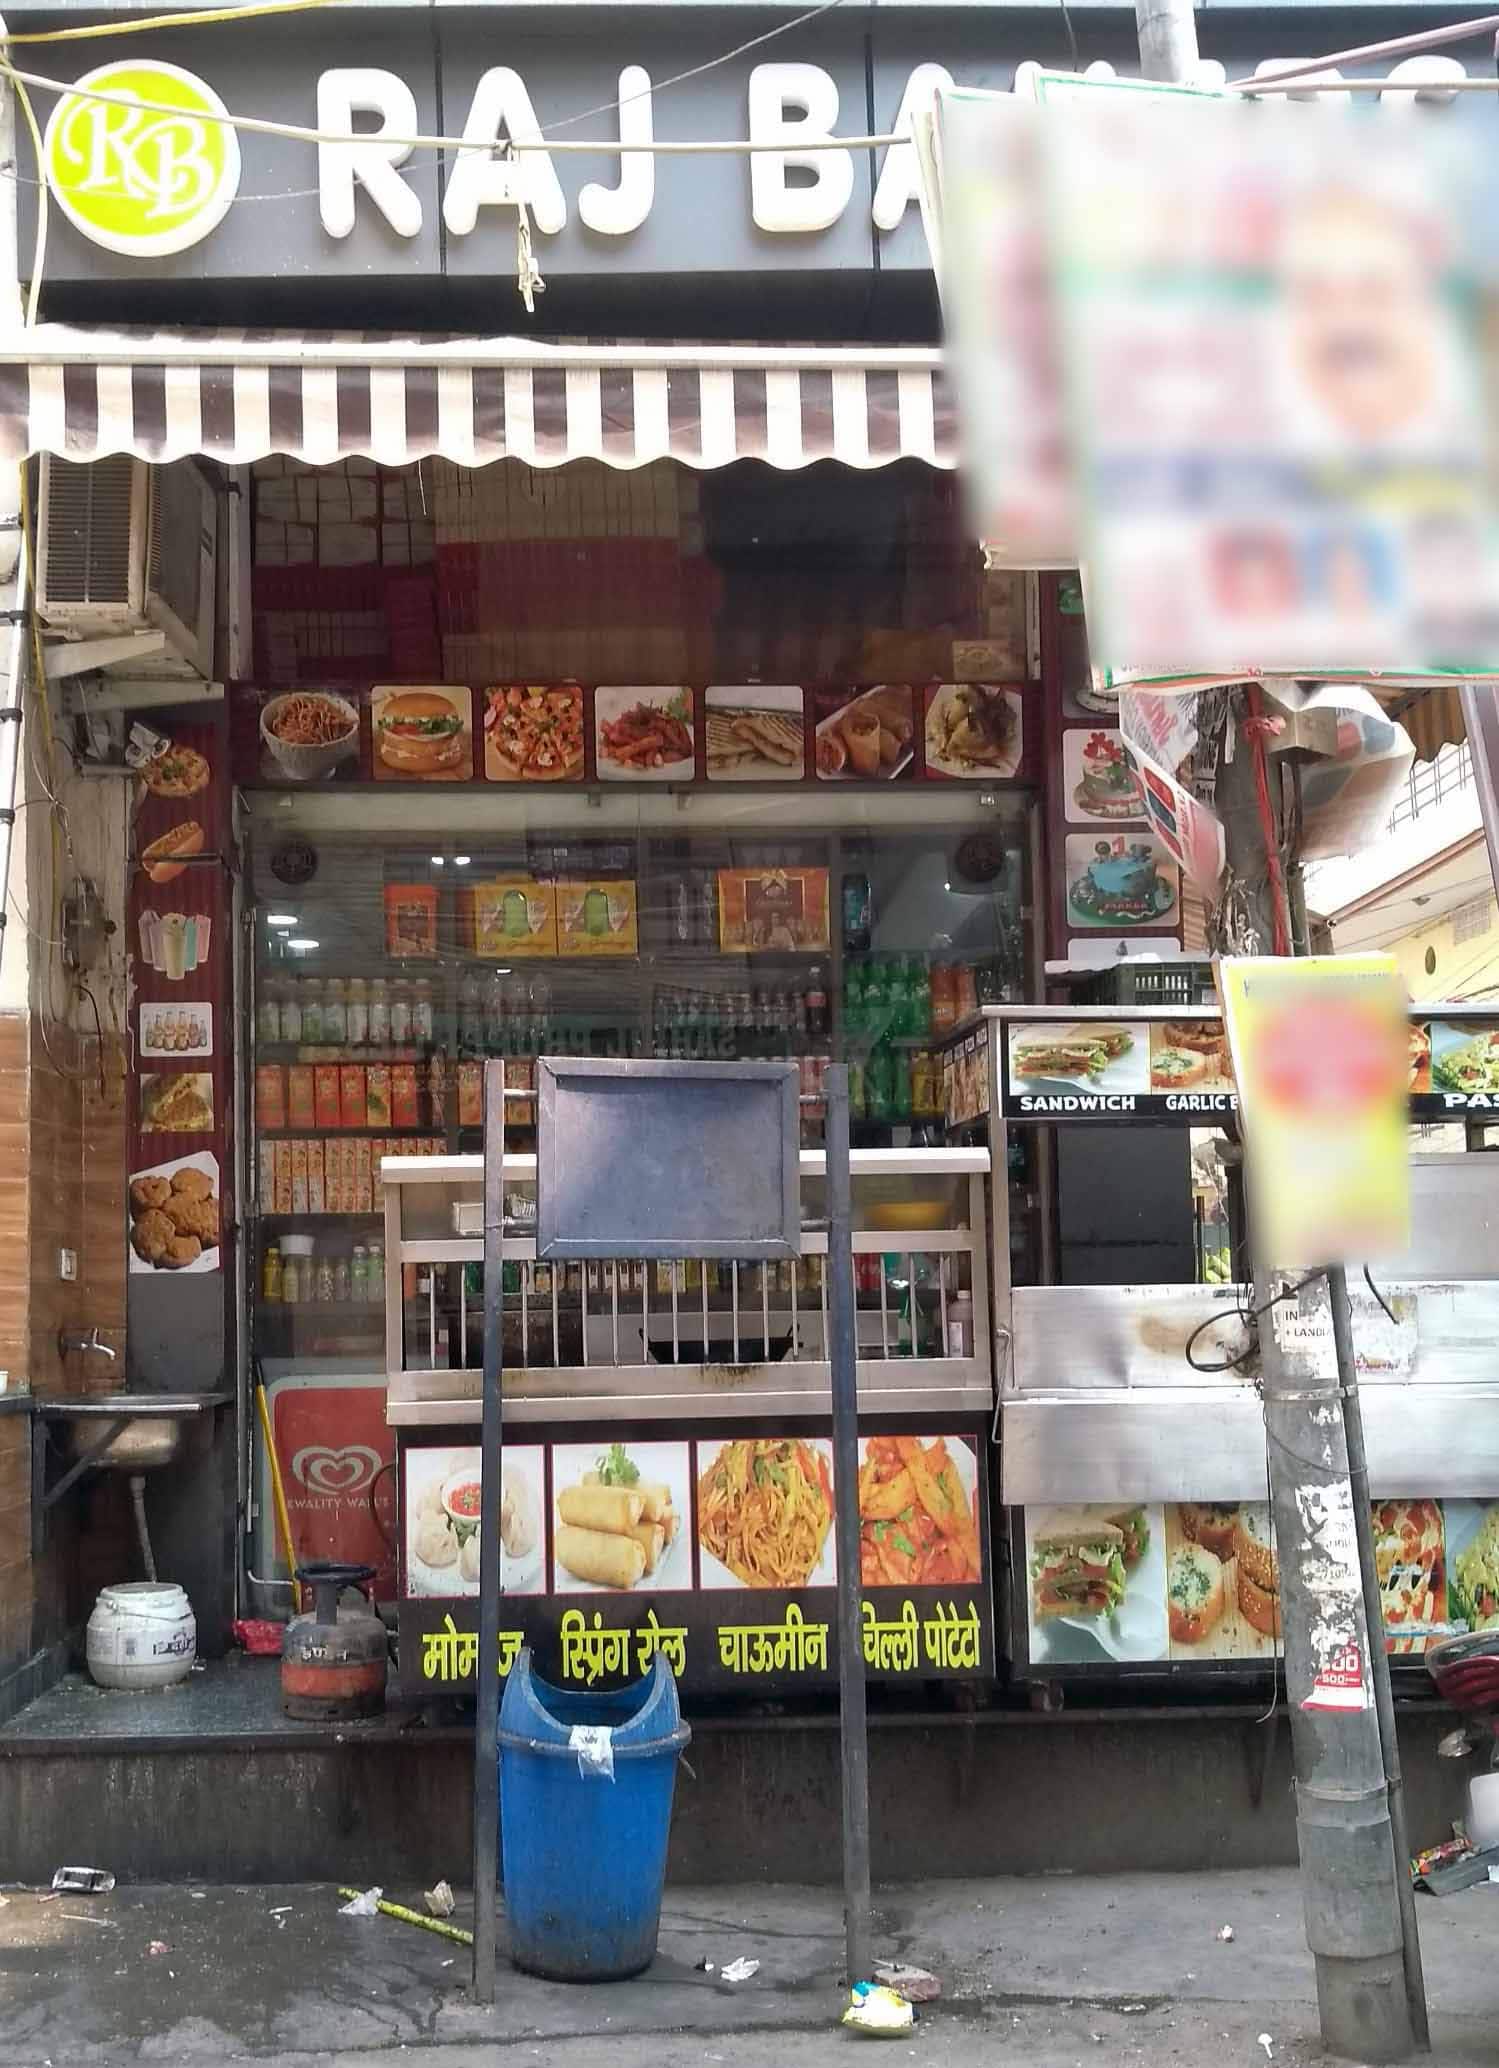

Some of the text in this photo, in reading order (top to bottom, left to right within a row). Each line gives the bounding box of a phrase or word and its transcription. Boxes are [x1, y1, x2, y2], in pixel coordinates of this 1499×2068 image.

[316, 65, 655, 239] RAJ
[1020, 1095, 1136, 1112] SANDWICH
[1165, 1094, 1226, 1111] GARLIC
[718, 1602, 829, 1673] चाऊमीन
[923, 1599, 981, 1669] पोटेटो
